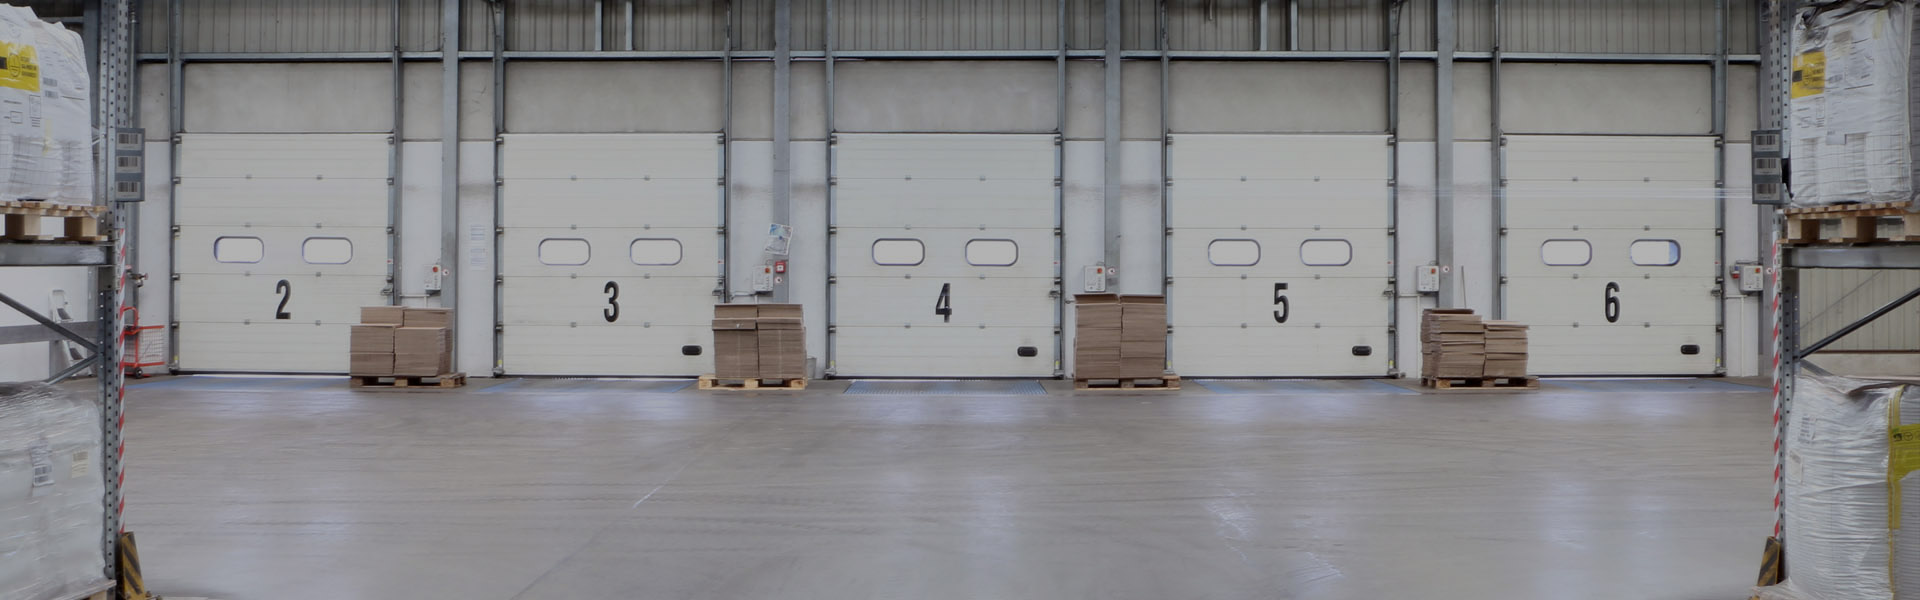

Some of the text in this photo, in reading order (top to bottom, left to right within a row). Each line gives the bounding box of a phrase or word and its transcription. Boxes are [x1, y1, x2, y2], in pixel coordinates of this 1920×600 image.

[275, 279, 291, 320] 2
[603, 280, 620, 323] 3
[935, 282, 953, 323] 4
[1273, 282, 1290, 324] 5
[1604, 281, 1621, 324] 6
